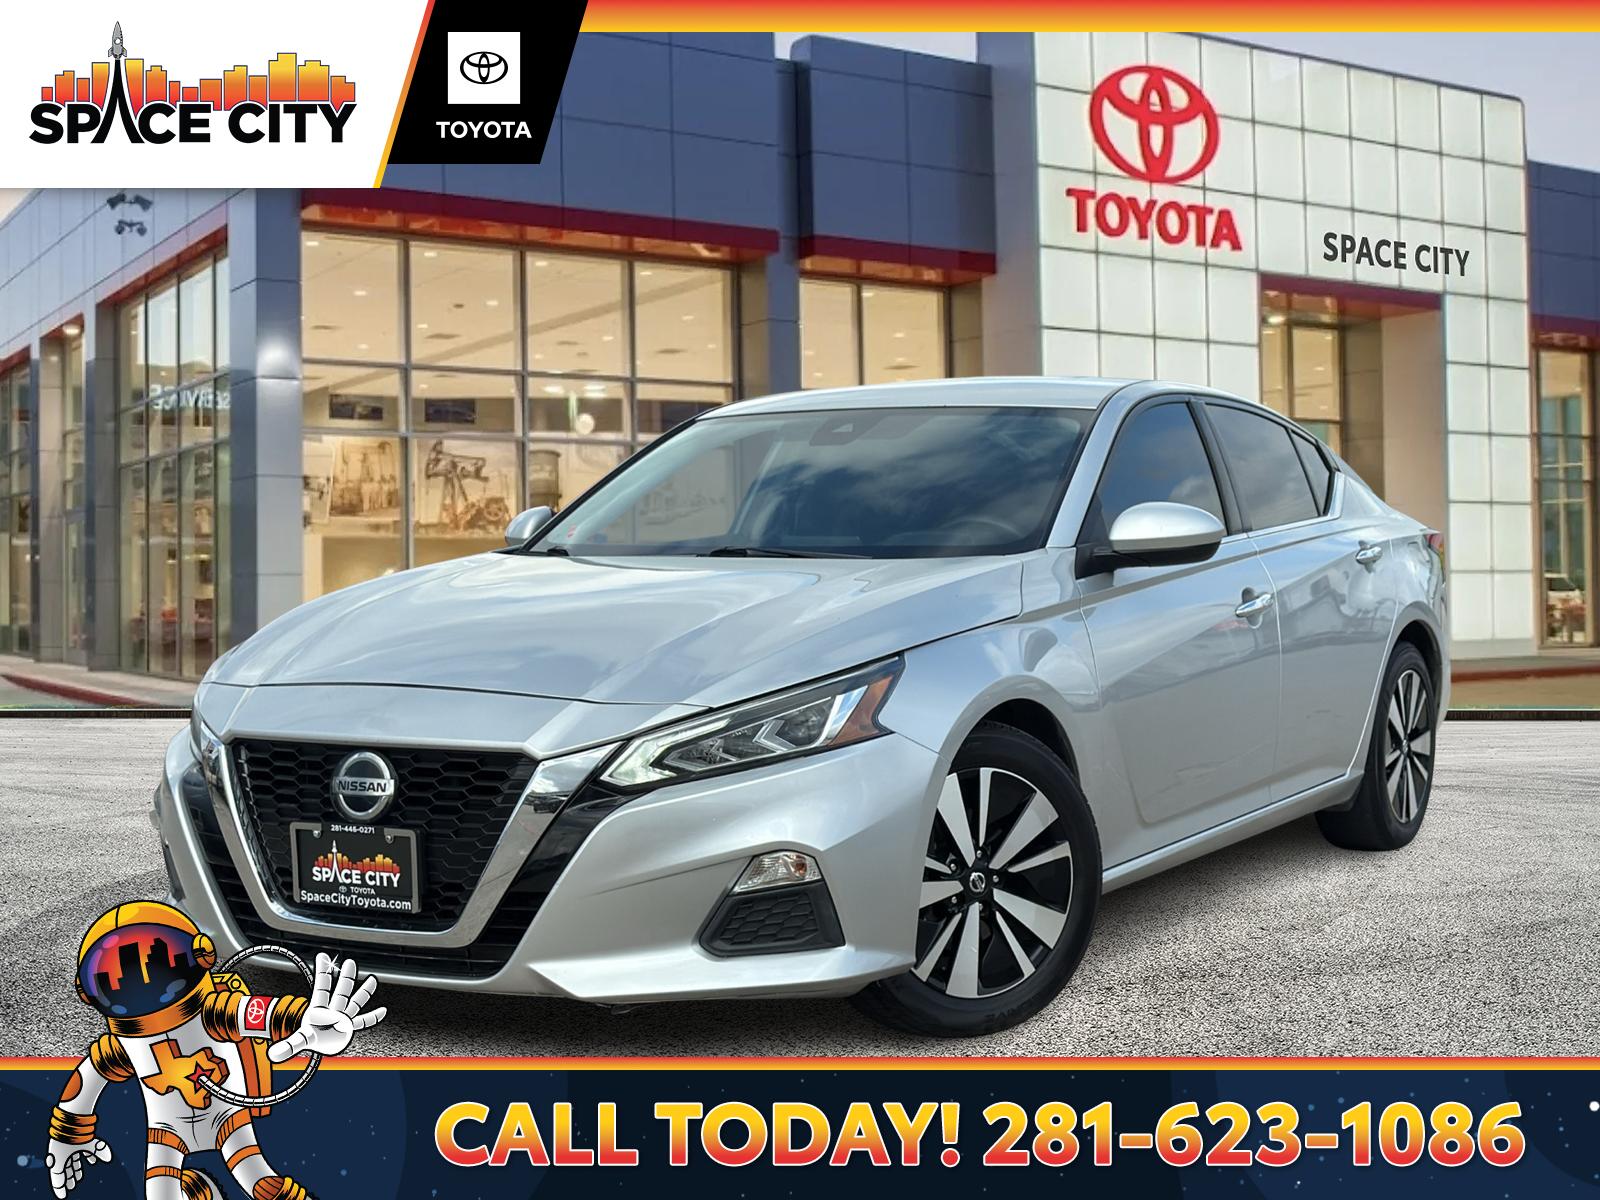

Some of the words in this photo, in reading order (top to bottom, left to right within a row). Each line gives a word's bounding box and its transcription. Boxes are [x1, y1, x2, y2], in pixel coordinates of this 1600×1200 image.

[1065, 187, 1242, 251] TOYOTA
[1322, 231, 1407, 270] SPACE
[1414, 244, 1470, 277] CITY
[337, 780, 387, 793] NISSAN
[312, 862, 361, 884] SPACE
[365, 871, 400, 887] CITY
[301, 890, 411, 910] SpaceCityToyota.com
[350, 886, 375, 895] TOYOTA
